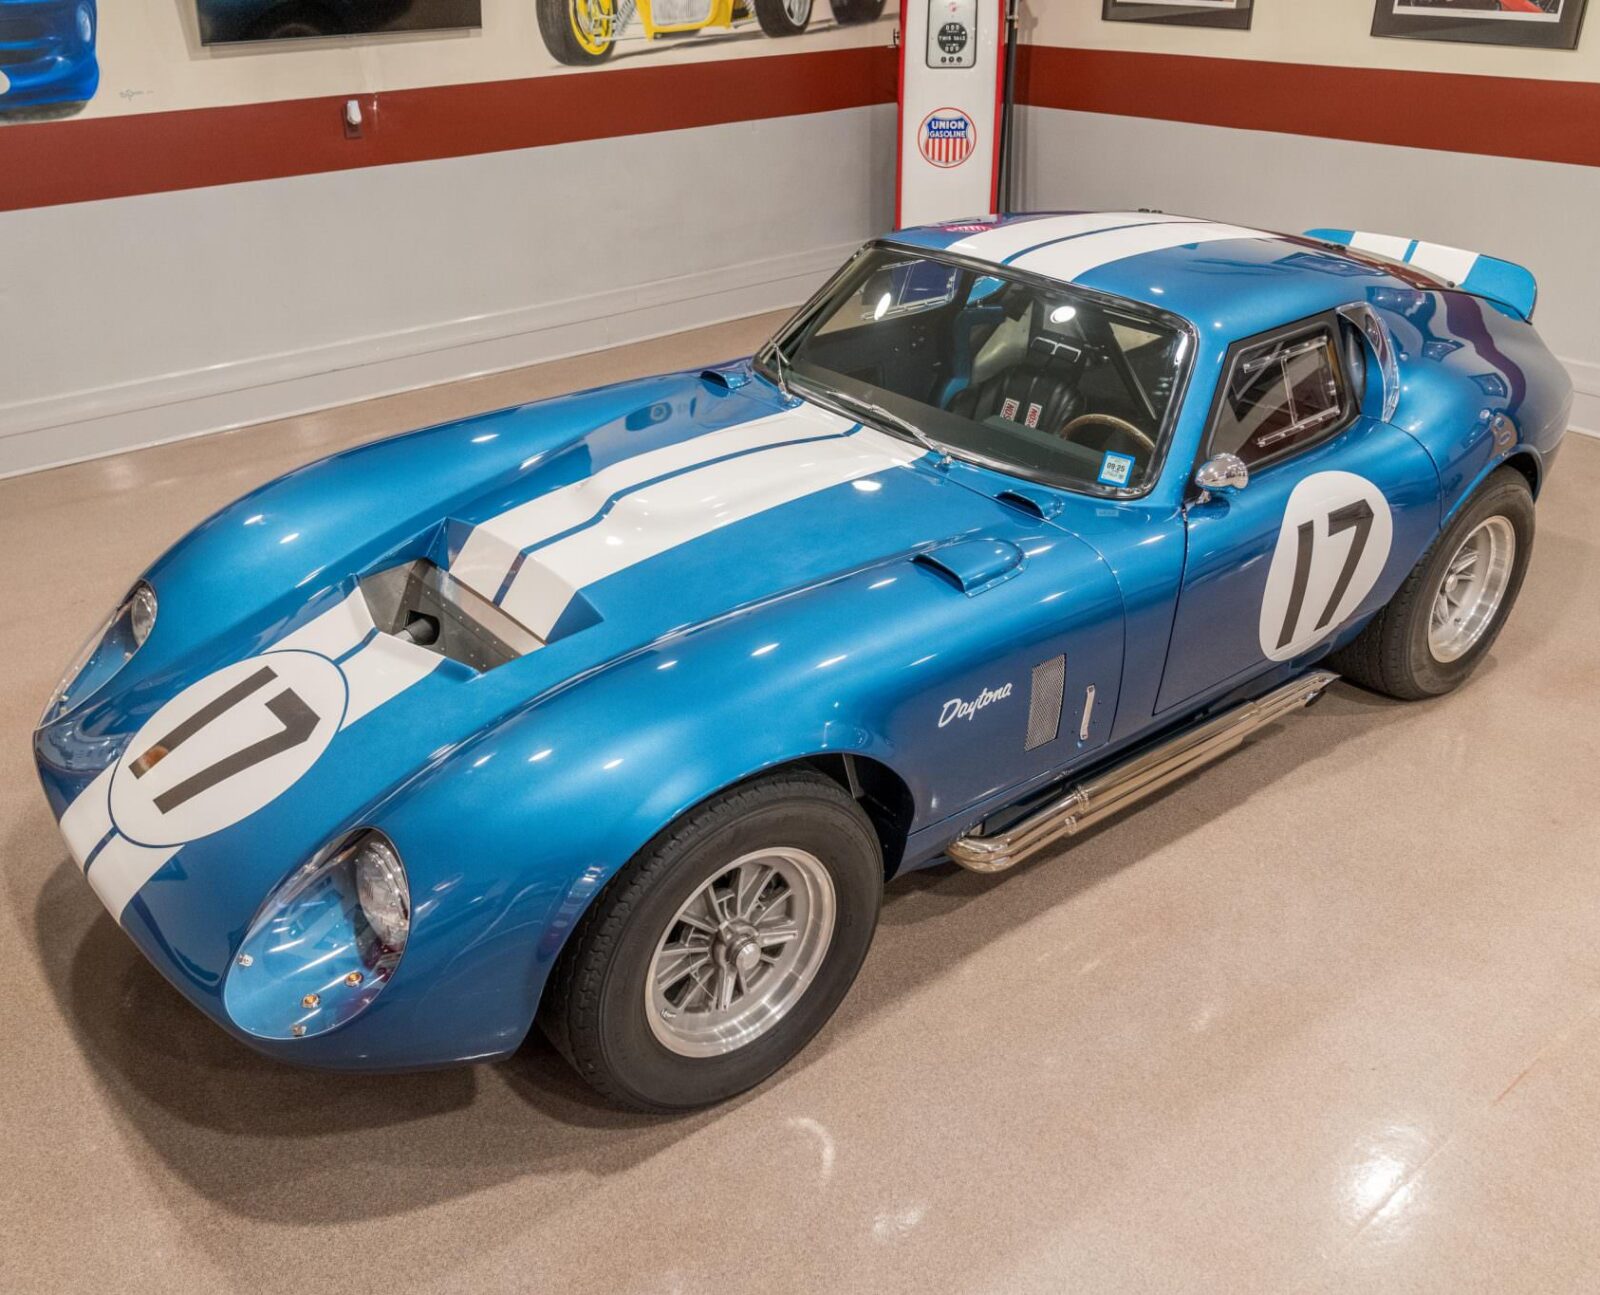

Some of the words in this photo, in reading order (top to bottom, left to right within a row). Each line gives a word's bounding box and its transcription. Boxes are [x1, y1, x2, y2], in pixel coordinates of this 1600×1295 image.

[930, 130, 966, 138] GASOLINE
[931, 120, 965, 130] UNION
[1275, 498, 1375, 650] 17
[938, 683, 1013, 728] Daytona
[128, 665, 321, 815] 17
